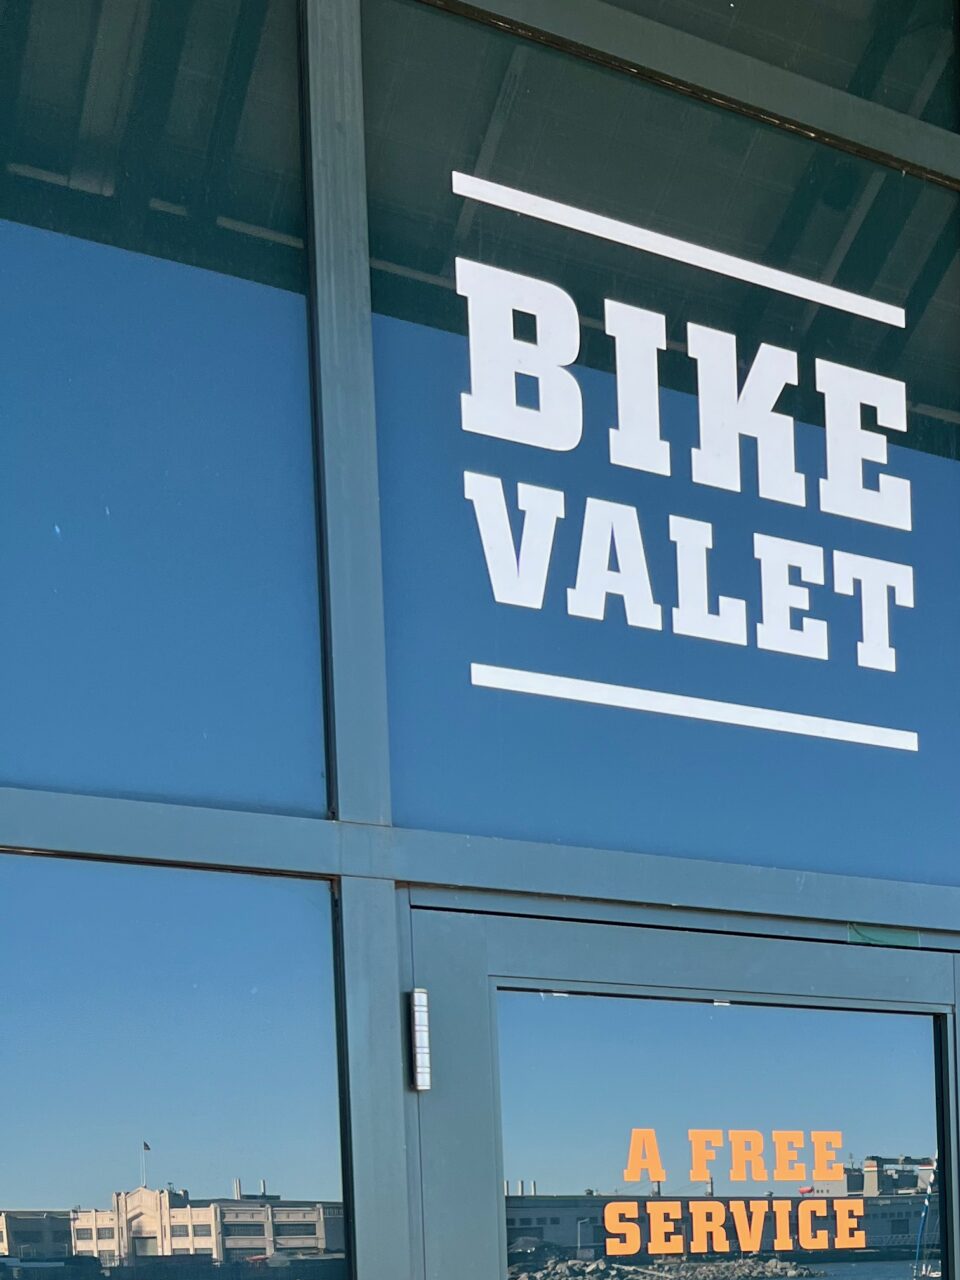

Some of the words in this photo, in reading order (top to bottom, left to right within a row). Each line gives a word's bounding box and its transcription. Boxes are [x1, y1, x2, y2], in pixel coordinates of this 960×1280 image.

[455, 256, 912, 531] BIKE
[463, 470, 916, 673] VALET
[623, 1128, 666, 1182] A
[688, 1129, 844, 1182] FREE
[604, 1199, 866, 1255] SERVICE
